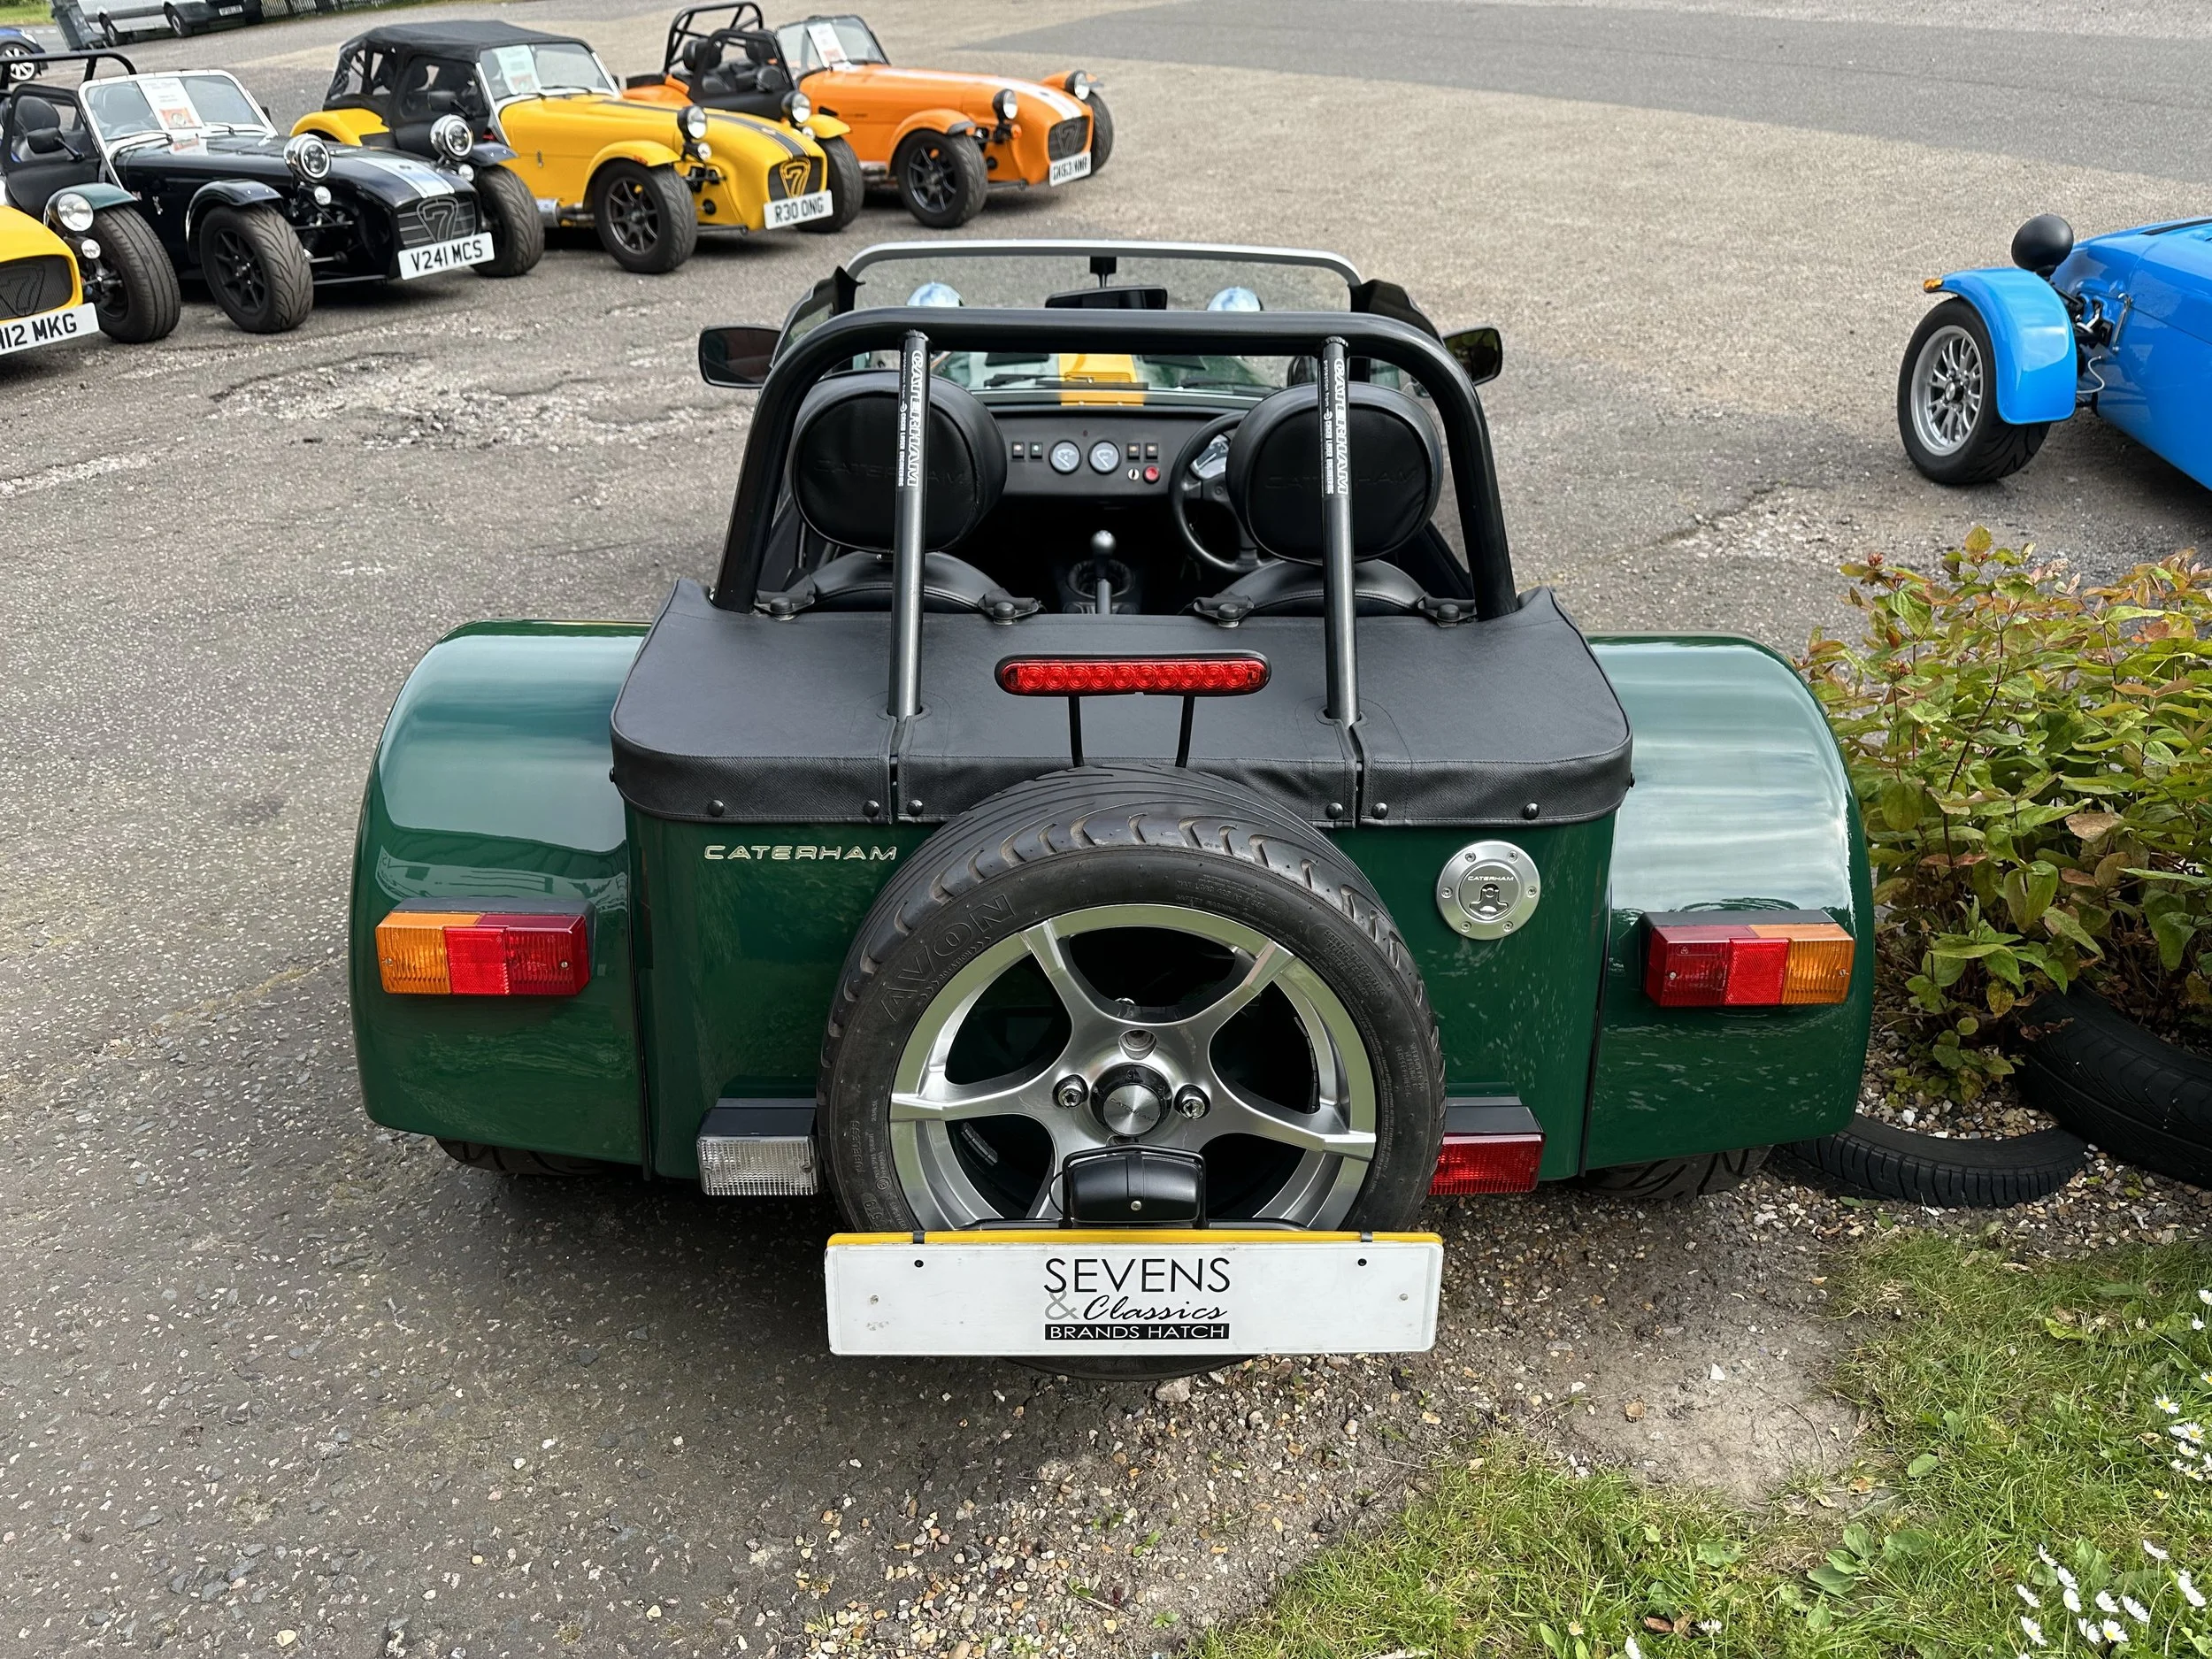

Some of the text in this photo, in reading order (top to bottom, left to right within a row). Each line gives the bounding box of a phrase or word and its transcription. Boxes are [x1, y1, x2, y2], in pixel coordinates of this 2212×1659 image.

[774, 196, 824, 223] R30 ONG
[411, 241, 483, 273] V241 MCS
[32, 312, 77, 342] MKG
[907, 349, 924, 488] CATERHAM
[1334, 358, 1348, 495] CATERHAM
[704, 845, 897, 861] CATERHAM
[880, 894, 1016, 1022] AVON
[1044, 1257, 1230, 1293] SEVENS
[1045, 1287, 1227, 1321] & Classics
[1050, 1325, 1224, 1339] BRANDS HATCH
